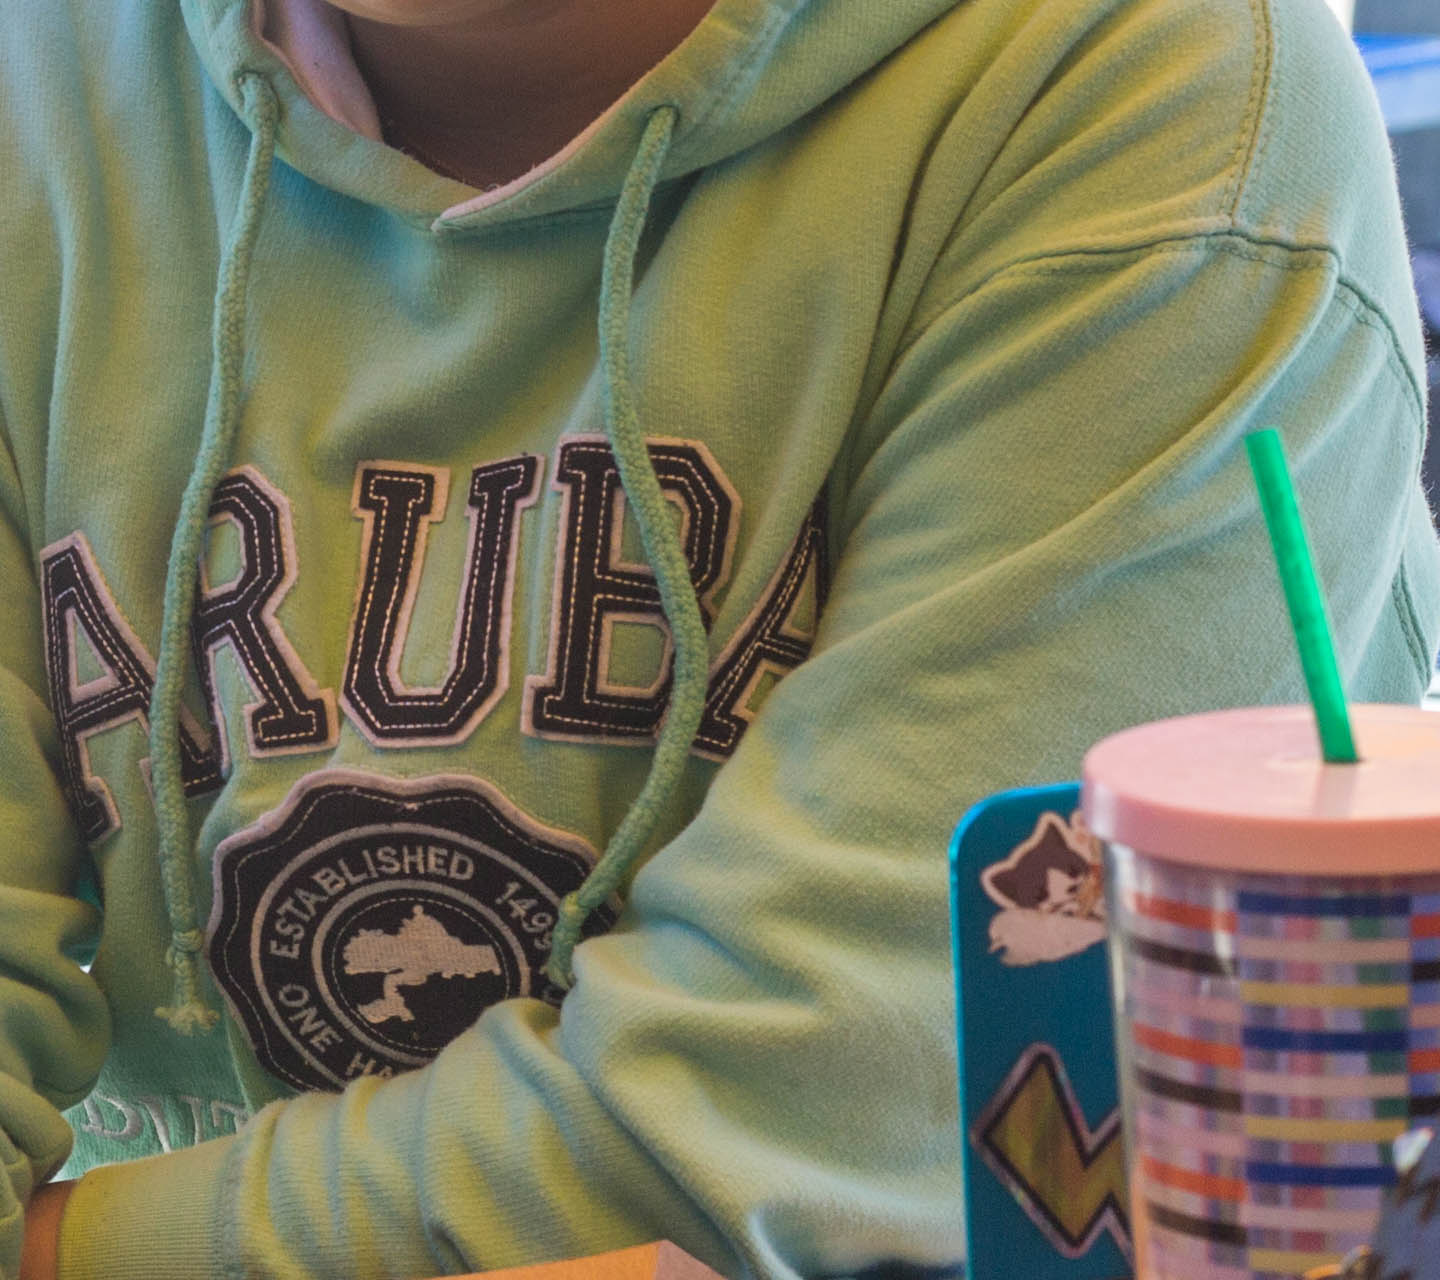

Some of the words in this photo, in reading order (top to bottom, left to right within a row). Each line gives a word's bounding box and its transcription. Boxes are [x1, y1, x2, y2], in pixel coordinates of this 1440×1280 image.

[39, 433, 832, 843] ARUBA
[269, 844, 475, 960] ESTABLISHED
[278, 983, 344, 1054] ONE
[345, 1051, 393, 1080] HA
